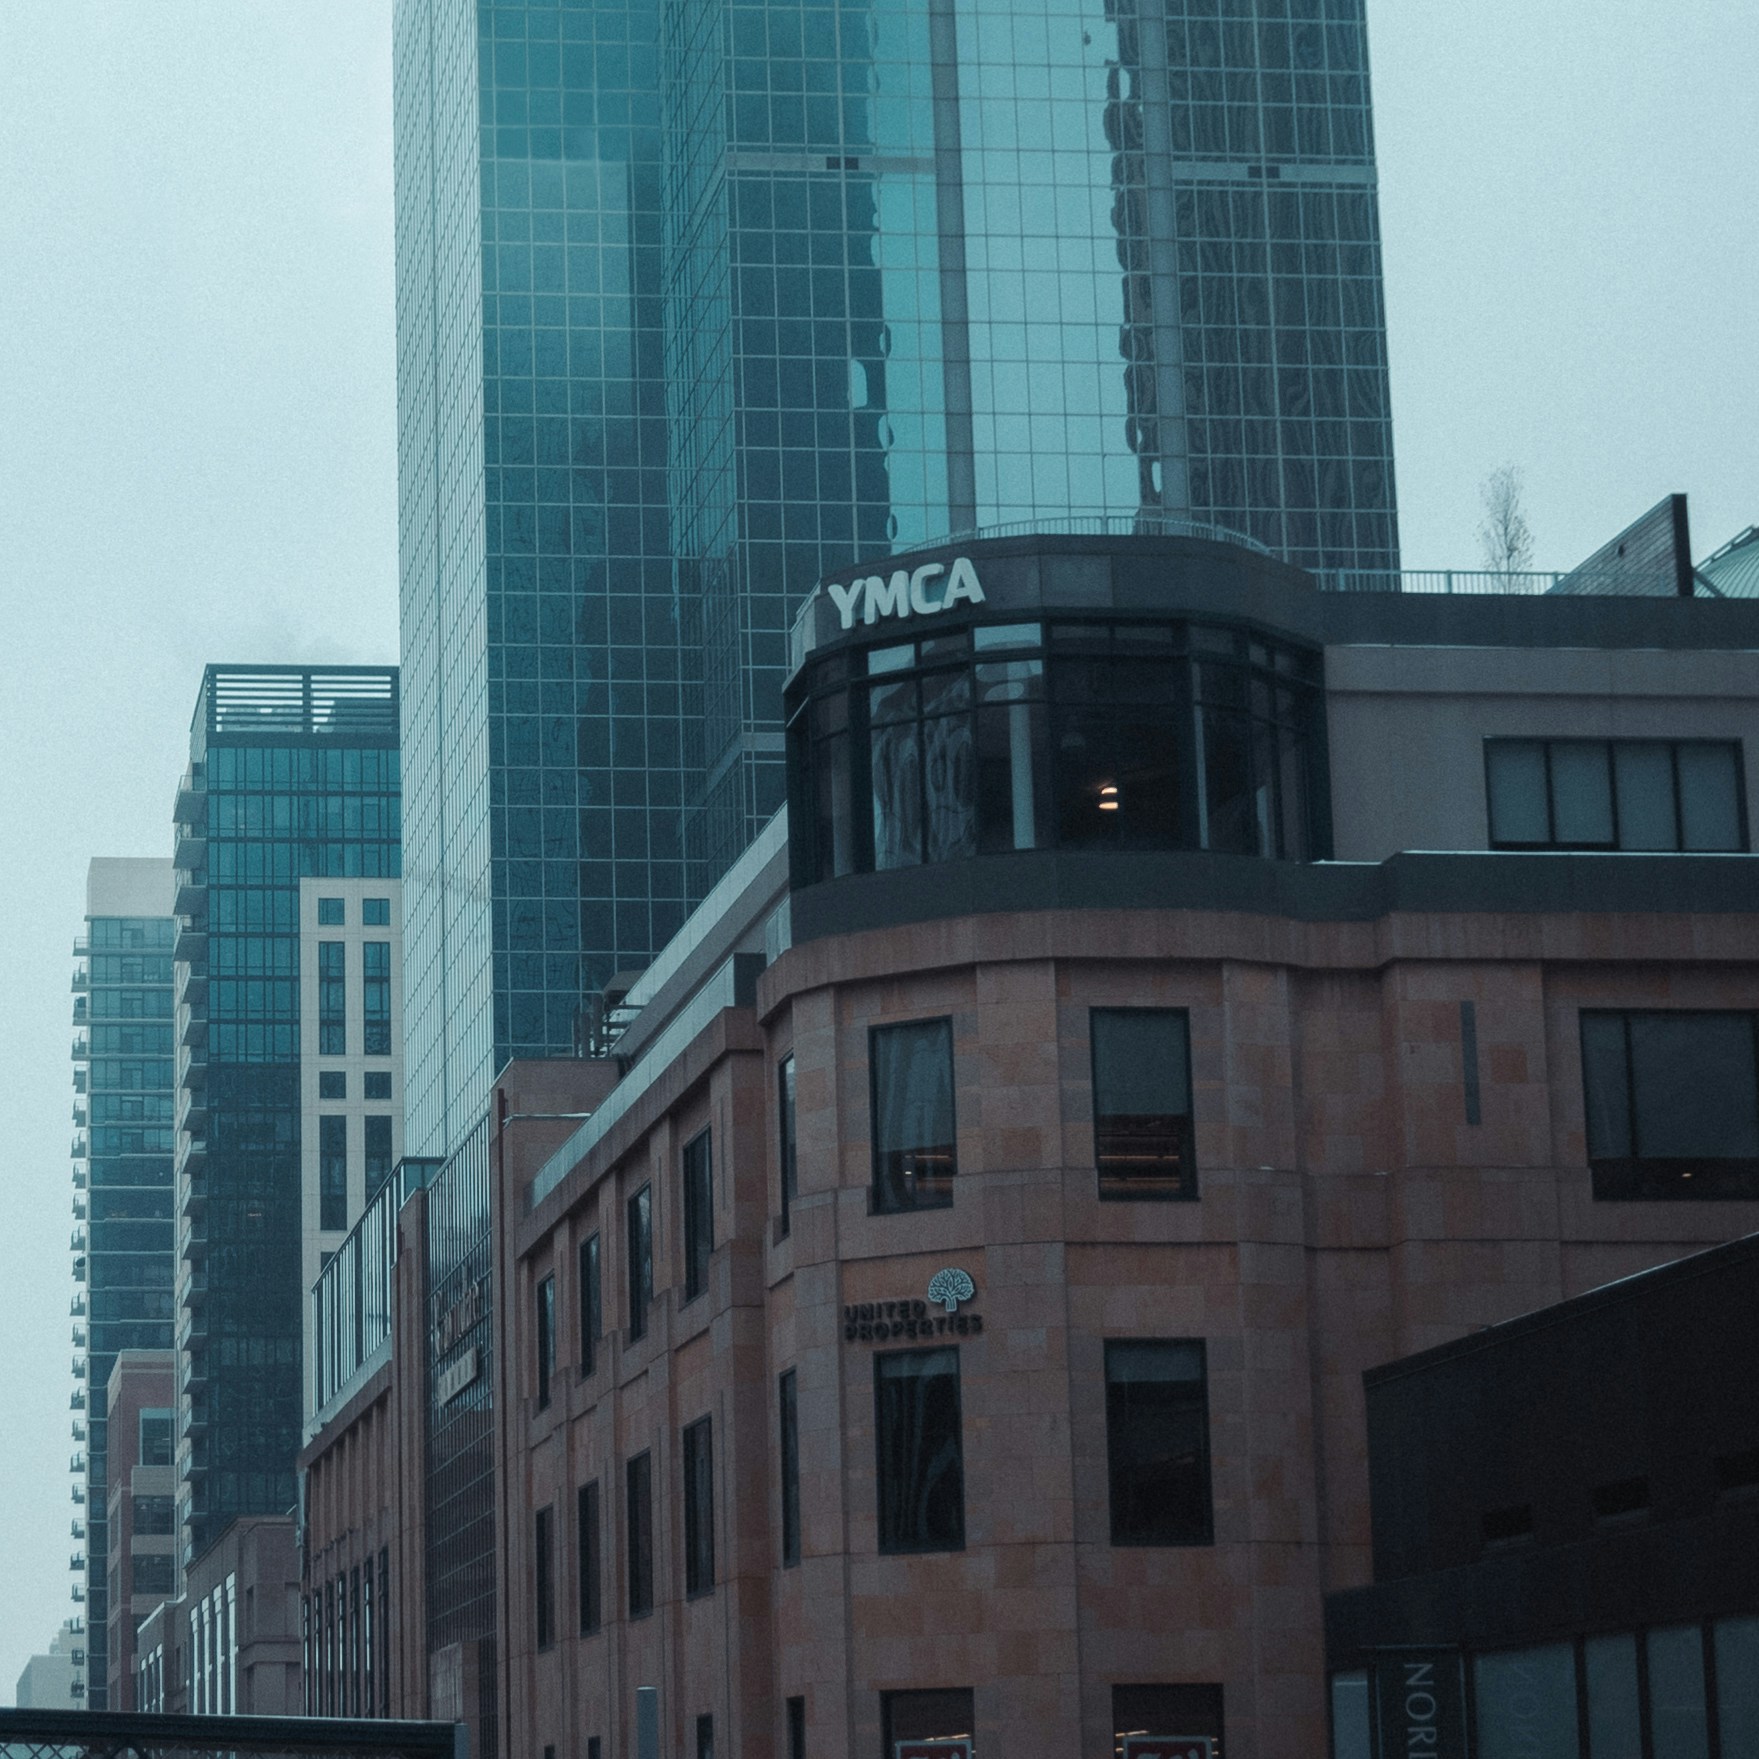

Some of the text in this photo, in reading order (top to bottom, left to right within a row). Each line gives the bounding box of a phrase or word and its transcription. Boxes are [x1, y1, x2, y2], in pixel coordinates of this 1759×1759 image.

[827, 556, 986, 630] YMCA
[844, 1299, 927, 1323] UNITED
[844, 1314, 983, 1341] PROPERTIES
